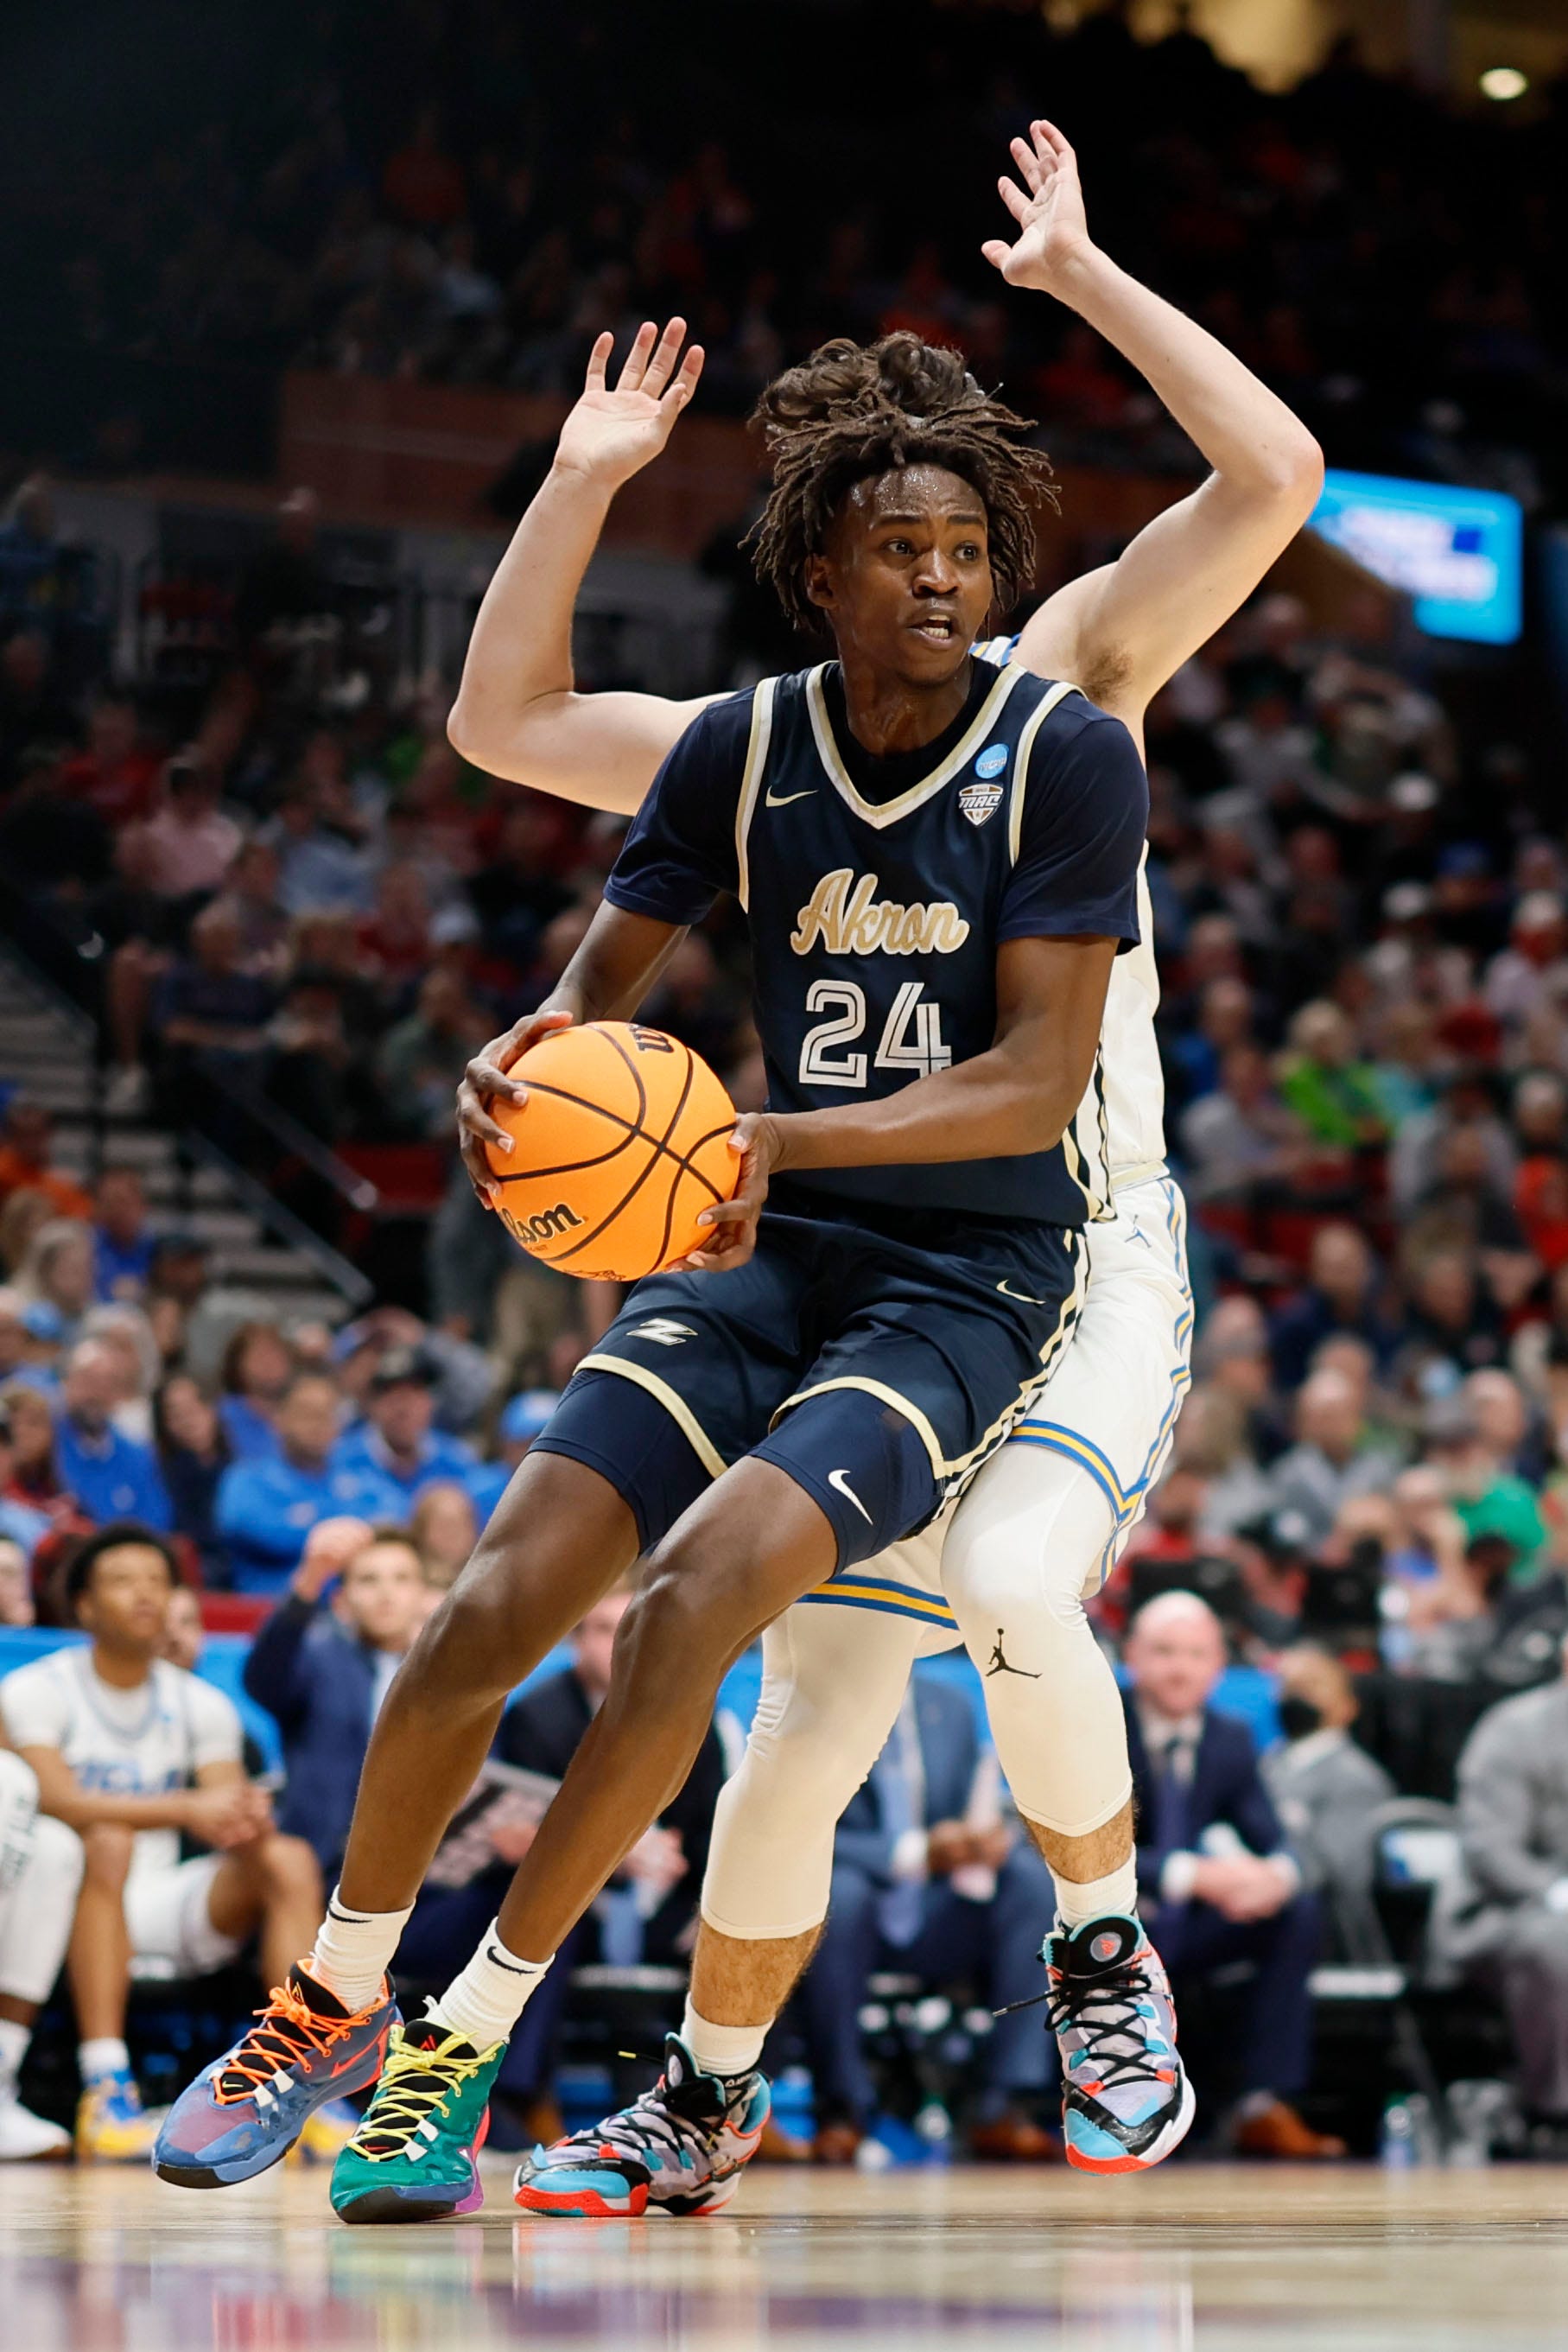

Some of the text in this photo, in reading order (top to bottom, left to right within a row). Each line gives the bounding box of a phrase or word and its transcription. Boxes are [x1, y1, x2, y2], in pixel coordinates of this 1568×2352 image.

[958, 795, 1001, 809] MAC
[790, 868, 969, 955] Akron
[798, 980, 951, 1088] 24
[500, 1202, 585, 1244] lson
